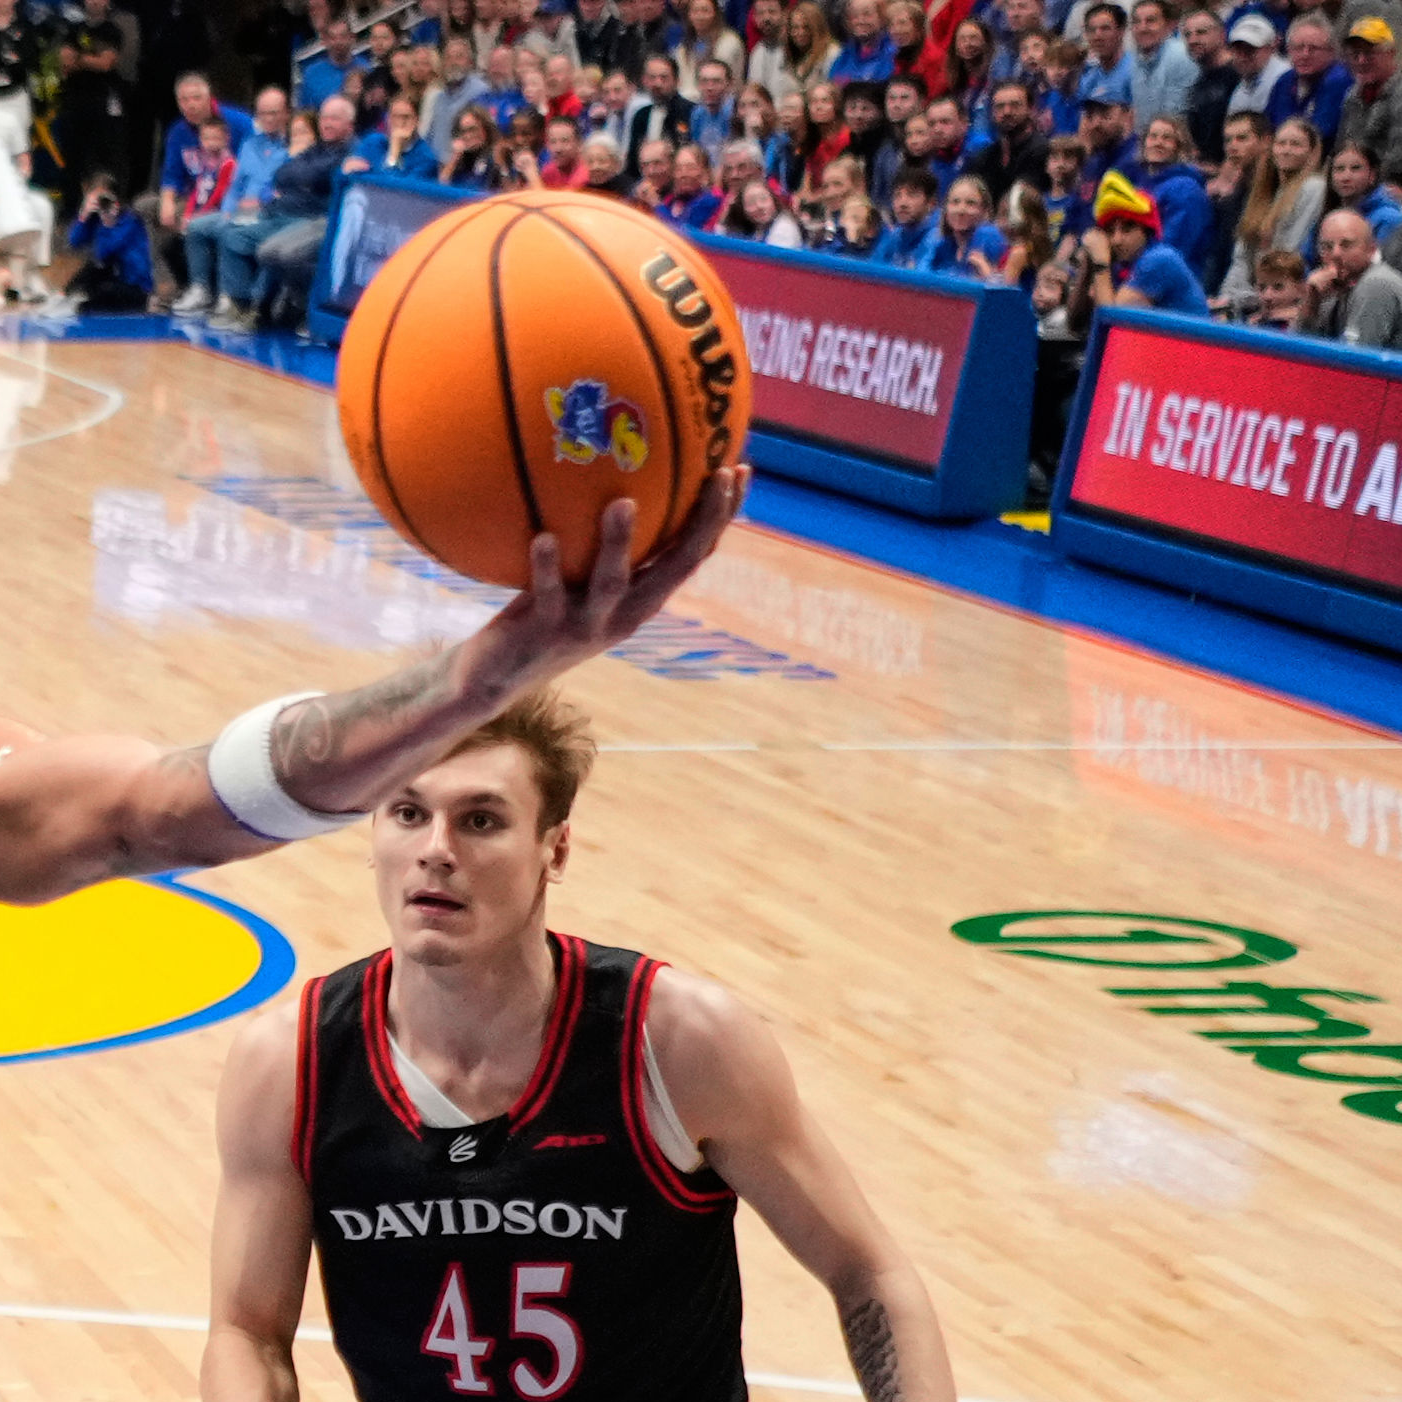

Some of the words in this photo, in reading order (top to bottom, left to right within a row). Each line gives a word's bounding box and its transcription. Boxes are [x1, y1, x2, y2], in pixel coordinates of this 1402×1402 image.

[641, 247, 737, 475] Wilso
[1103, 380, 1153, 460] IN
[1150, 392, 1305, 498] SERVICE
[1304, 424, 1359, 510] TO
[1354, 441, 1402, 526] A
[329, 1199, 628, 1241] DAVIDSON
[420, 1262, 585, 1402] 45
